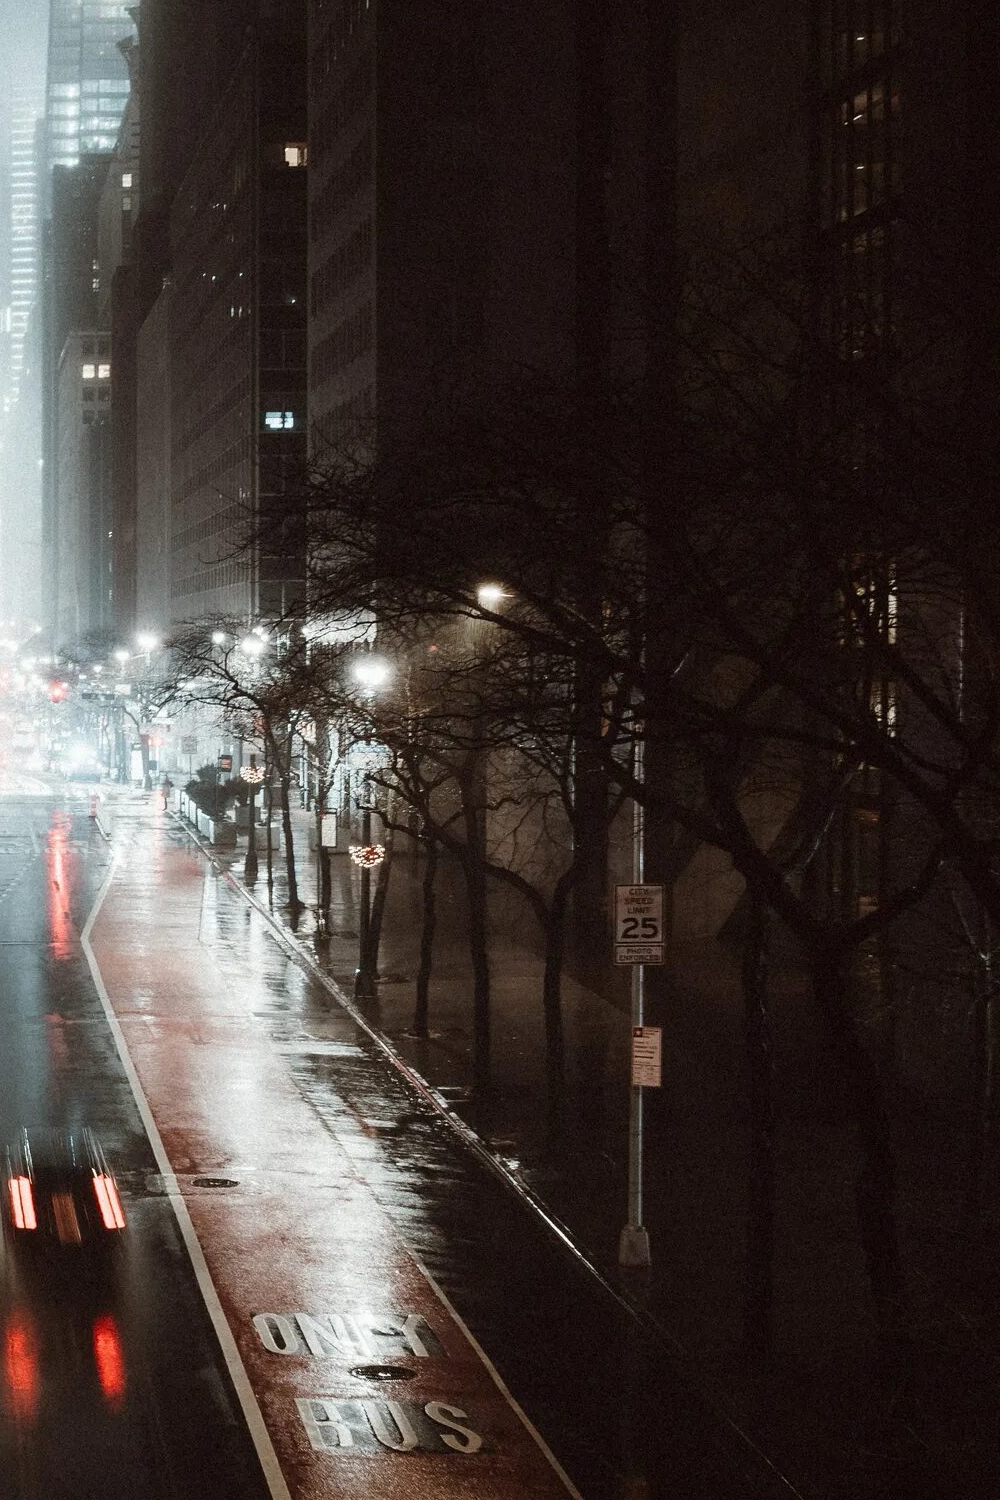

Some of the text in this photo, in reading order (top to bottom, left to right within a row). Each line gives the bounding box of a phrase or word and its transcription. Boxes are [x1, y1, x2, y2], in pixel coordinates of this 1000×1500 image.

[621, 917, 658, 938] 25
[252, 1313, 430, 1357] ONLY
[294, 1398, 483, 1454] BUS
